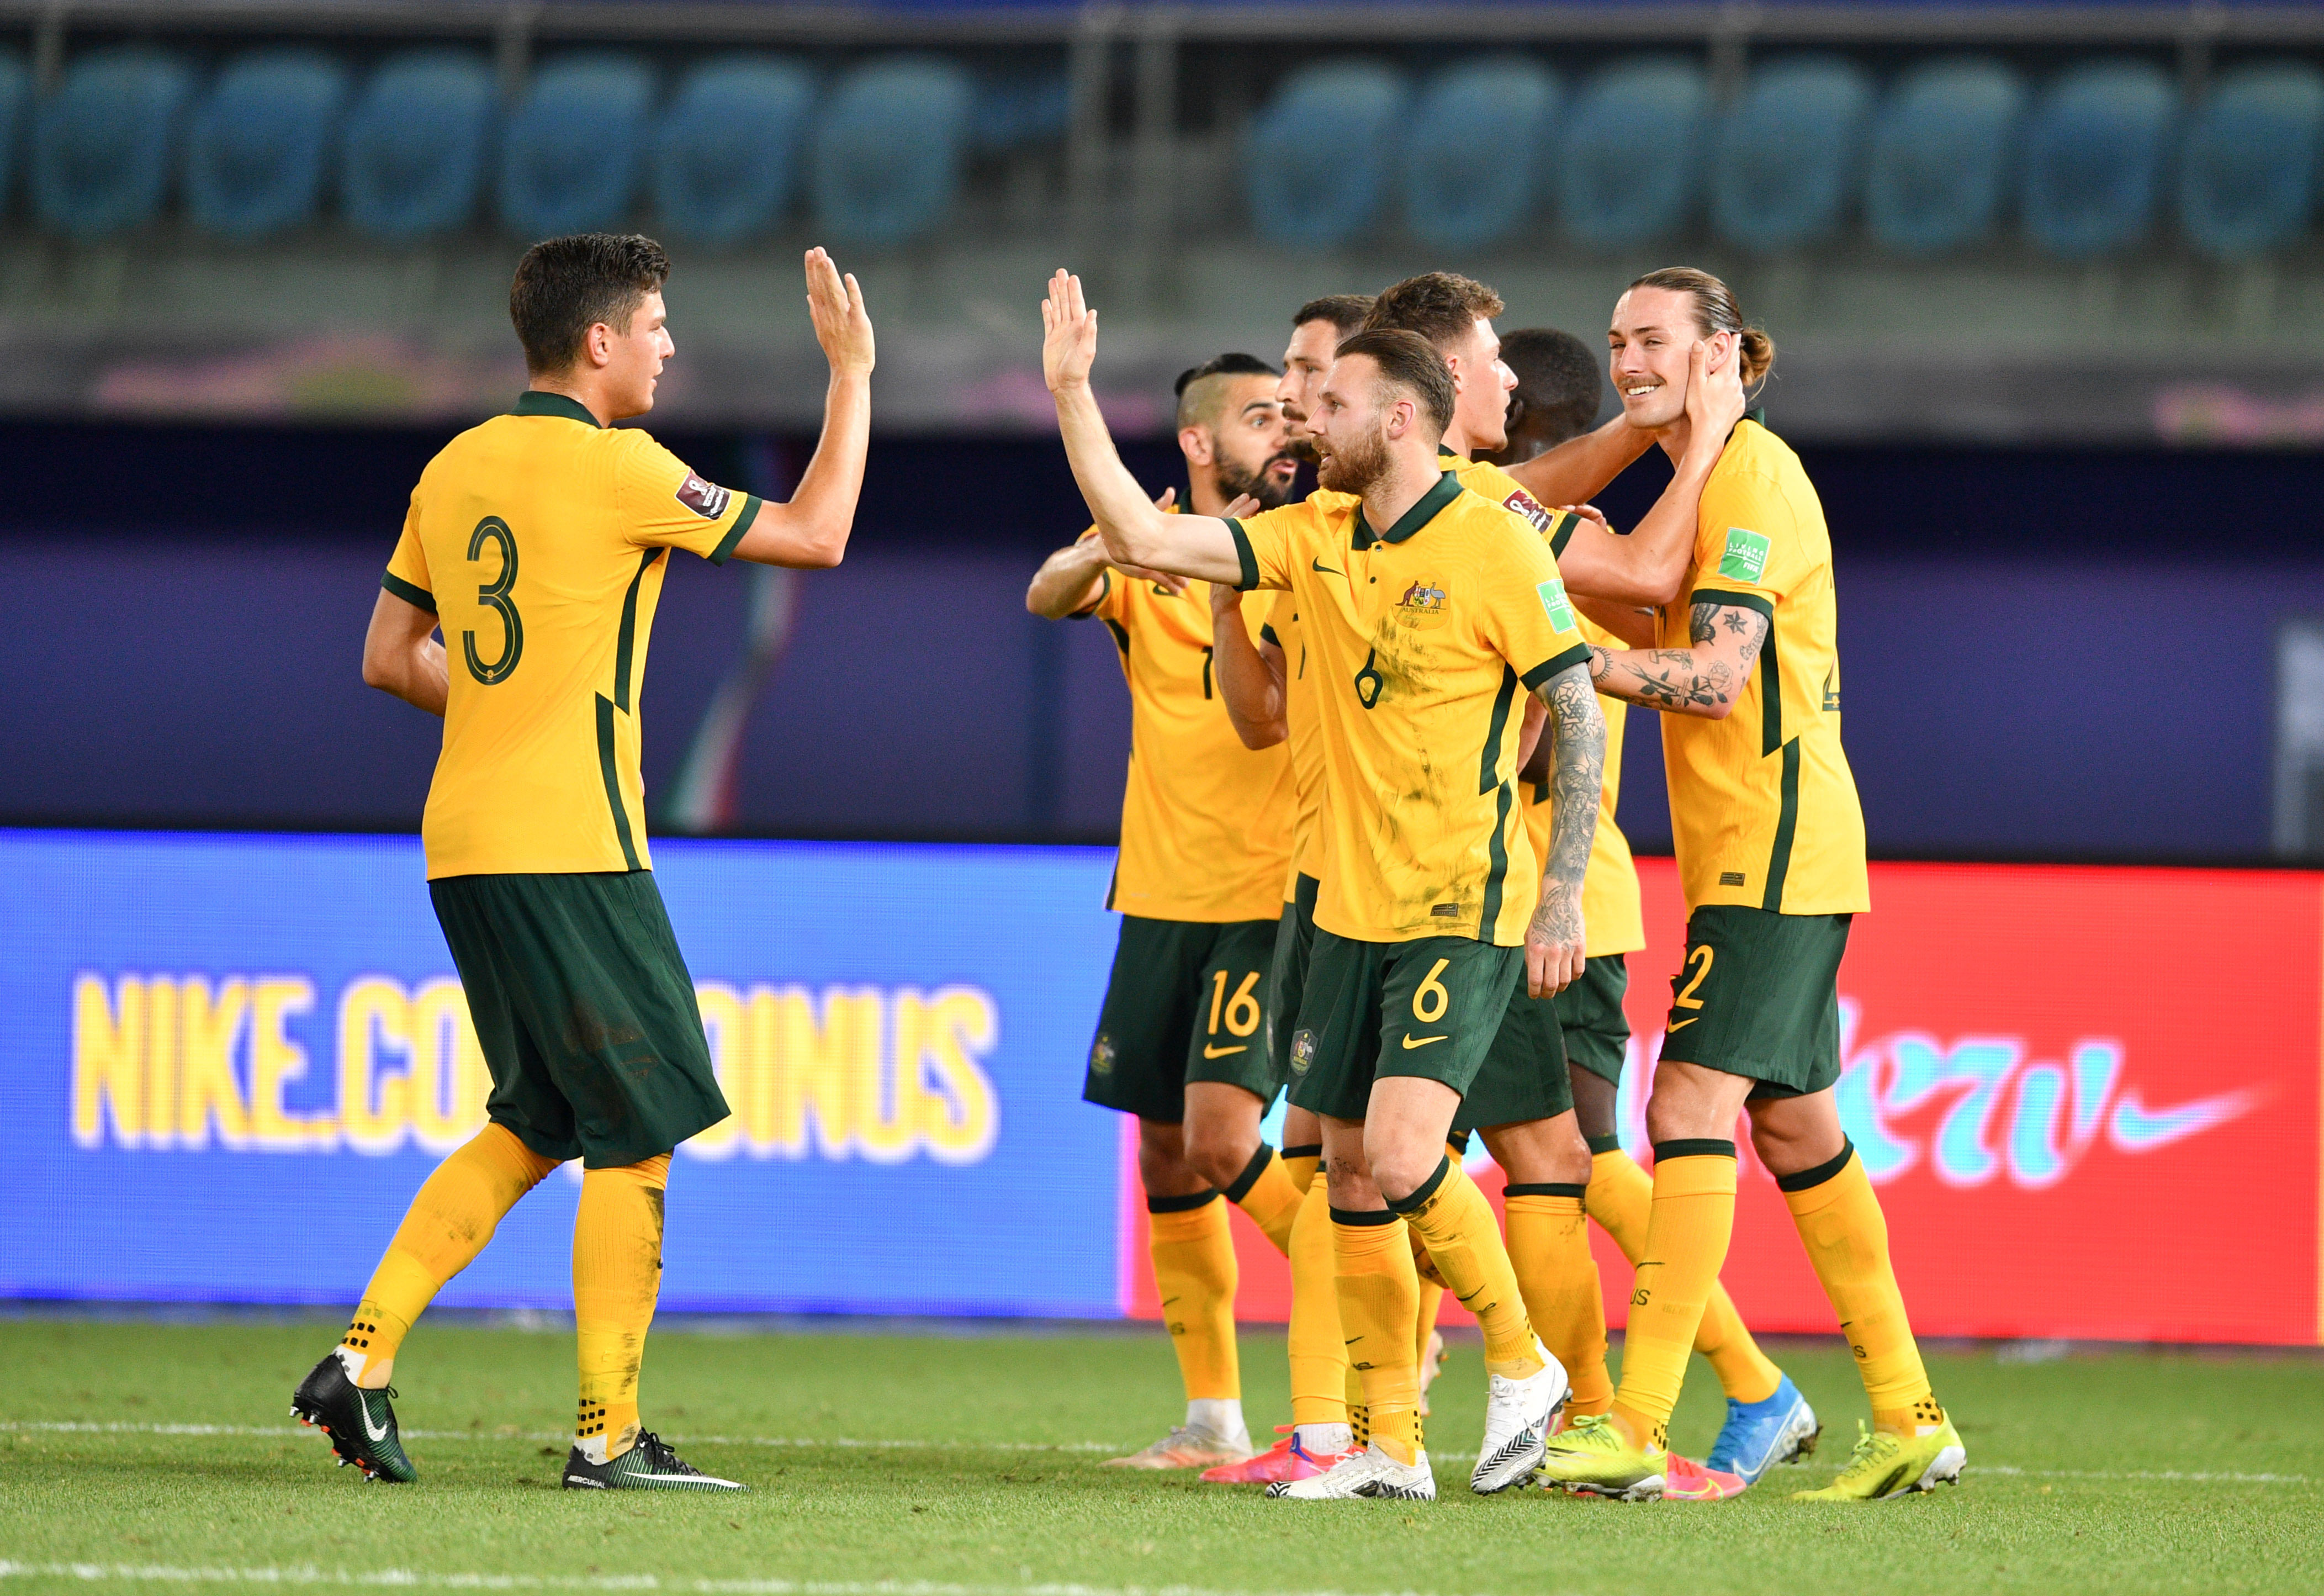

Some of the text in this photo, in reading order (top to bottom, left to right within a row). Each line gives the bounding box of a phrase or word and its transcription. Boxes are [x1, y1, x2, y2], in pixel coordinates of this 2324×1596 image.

[1728, 548, 1761, 562] FOOTBALL
[1729, 542, 1764, 557] LIVING
[1743, 562, 1759, 573] FIFA
[463, 515, 524, 686] 3
[1354, 647, 1383, 710] 6
[1208, 969, 1261, 1037] 16
[1412, 958, 1450, 1023] 6
[567, 1475, 606, 1489] MERCURIAL
